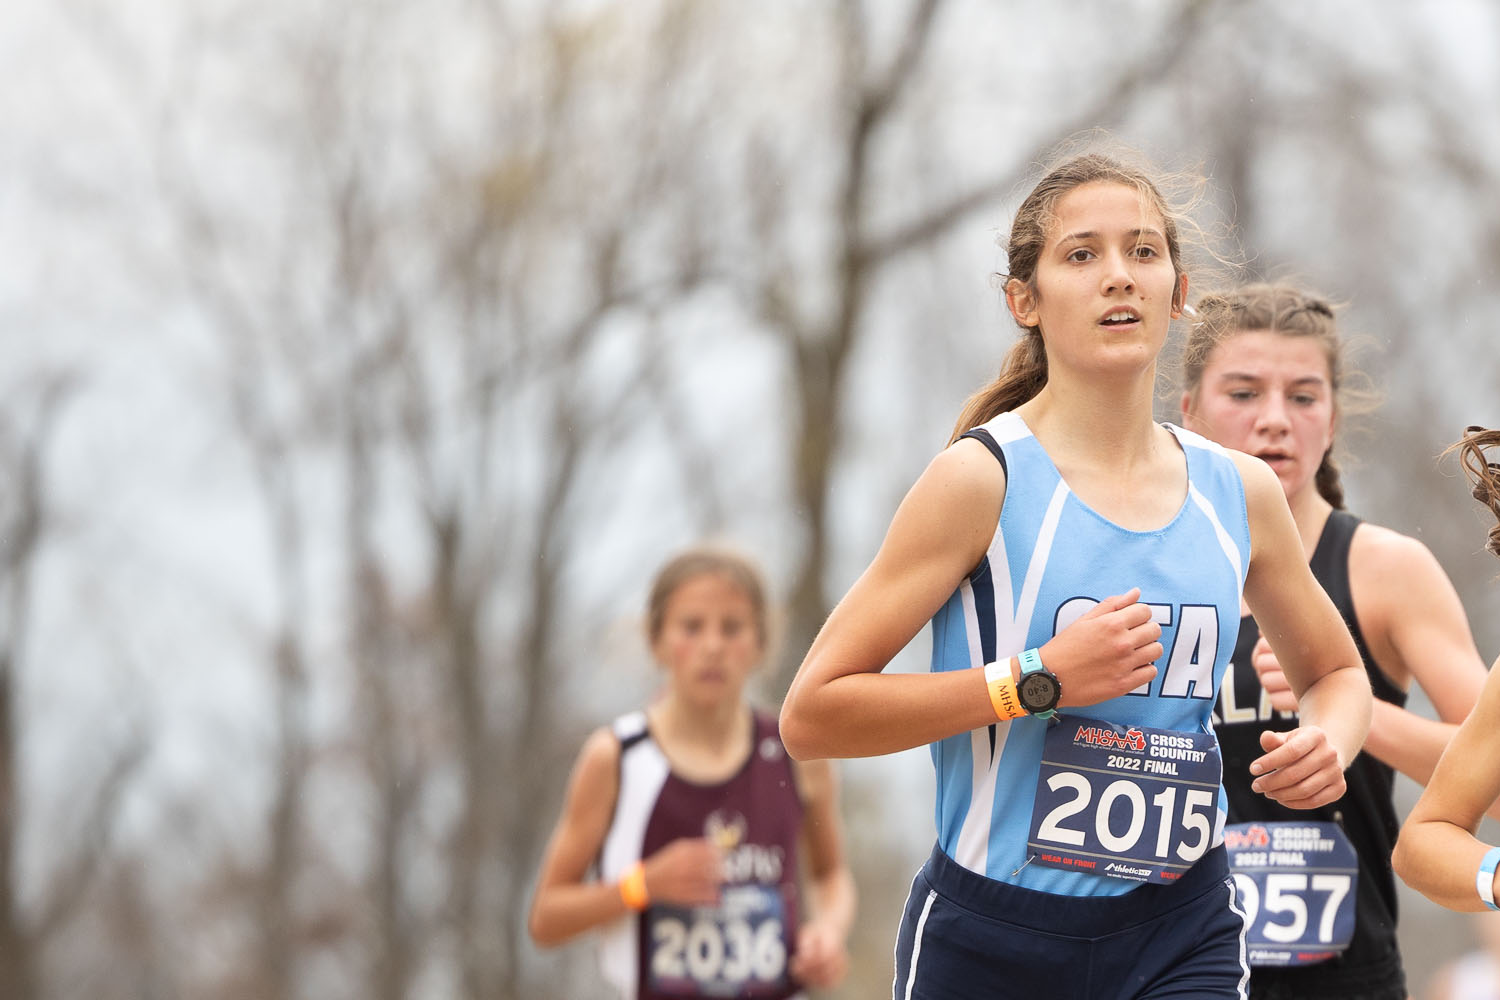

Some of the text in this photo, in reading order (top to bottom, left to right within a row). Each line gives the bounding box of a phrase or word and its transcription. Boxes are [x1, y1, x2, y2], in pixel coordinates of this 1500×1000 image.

[1073, 725, 1139, 750] MHSAA
[1149, 733, 1194, 750] CROSS
[1149, 746, 1207, 763] COUNTRY
[1106, 755, 1179, 776] 2022 FINAL
[1036, 771, 1214, 863] 2015
[1268, 852, 1307, 866] FINAL
[650, 918, 786, 981] 2036
